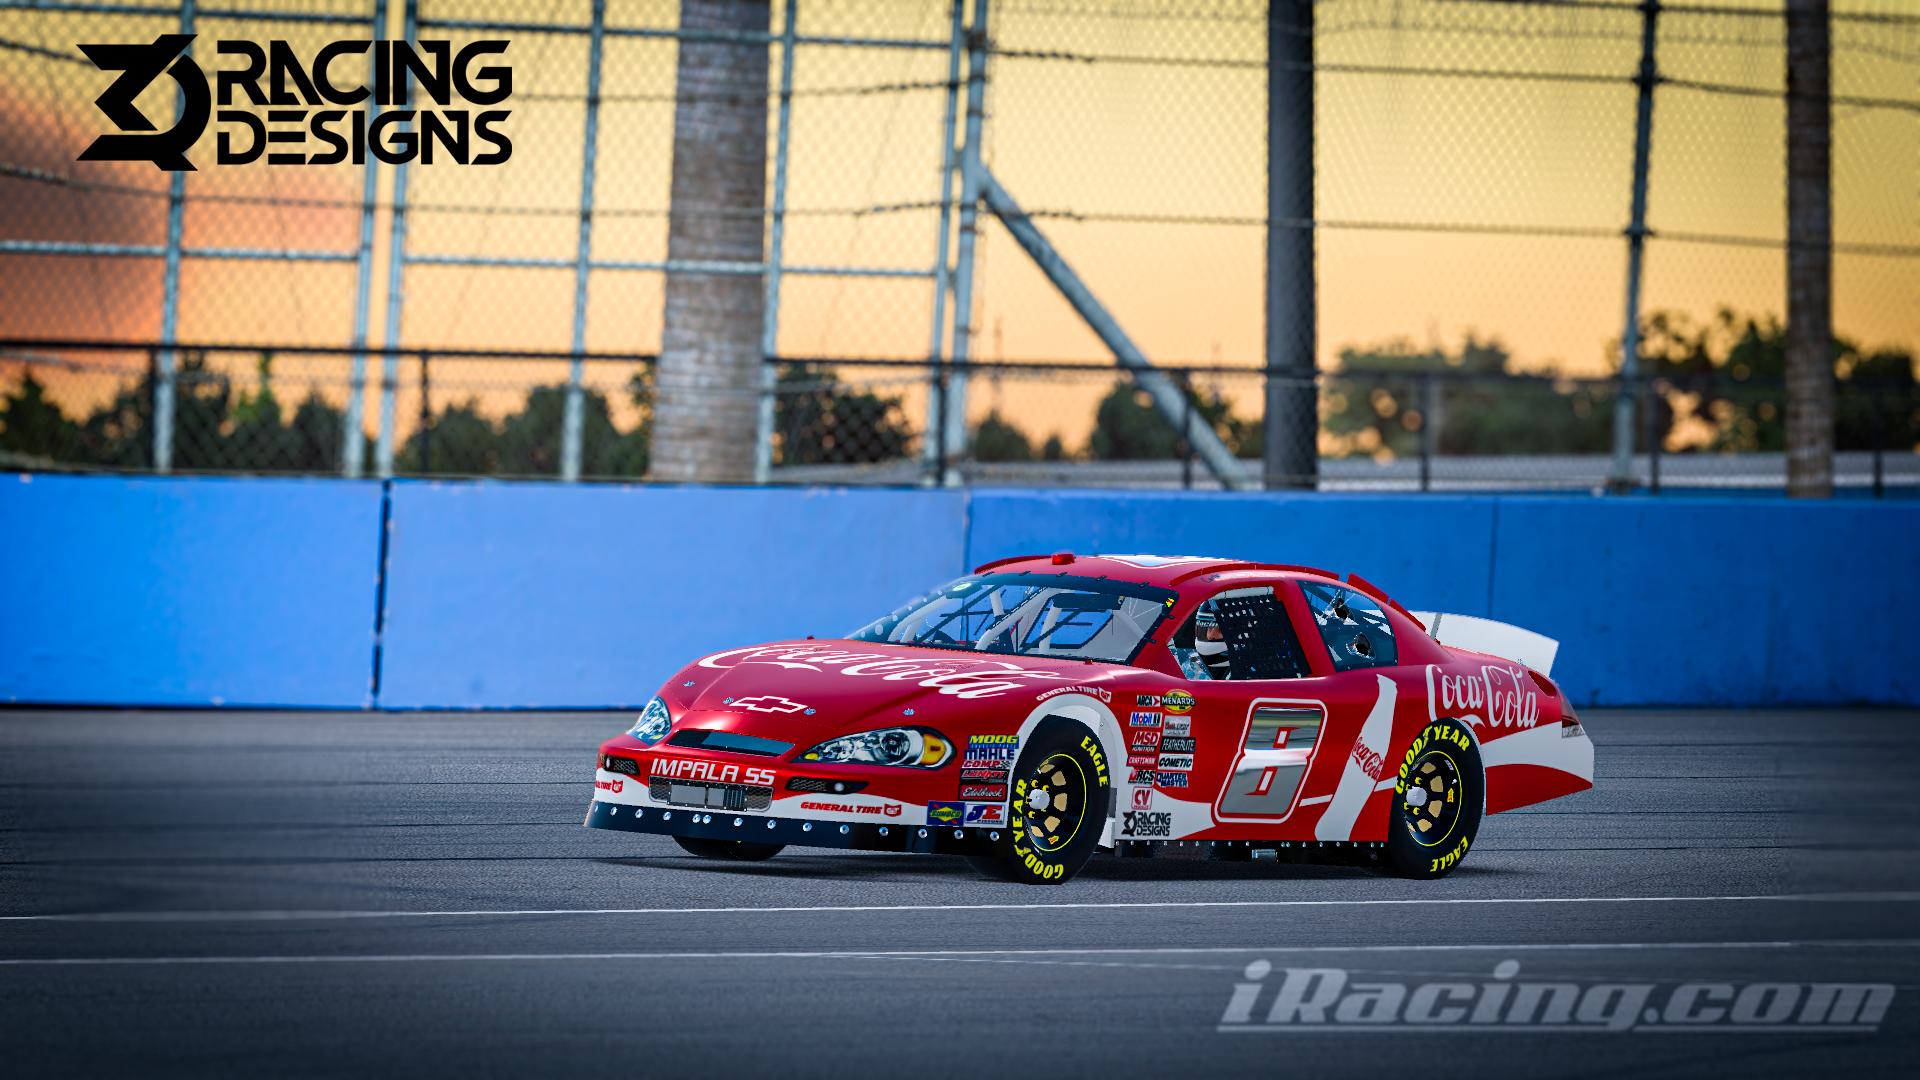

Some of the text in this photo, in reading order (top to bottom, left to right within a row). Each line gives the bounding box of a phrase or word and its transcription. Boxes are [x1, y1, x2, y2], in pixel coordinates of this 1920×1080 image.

[1036, 685, 1098, 701] GENERAL TIRE
[1161, 696, 1196, 706] MENARDS
[1131, 712, 1152, 725] Mobil
[969, 735, 1019, 744] MOOG
[1134, 732, 1159, 746] MSD
[1161, 738, 1195, 751] FEATHERLITE
[964, 749, 1015, 760] MAHLE
[1080, 735, 1109, 787] EAGLE
[1214, 697, 1328, 824] 8
[1395, 724, 1470, 794] GOODYEAR
[963, 760, 1001, 768] COMP
[1159, 757, 1193, 768] COMETIC
[650, 758, 777, 786] IMPALA SS
[1156, 772, 1187, 783] QUARTER
[1160, 779, 1188, 787] MASTER
[962, 787, 1003, 797] Edelbrock
[1134, 789, 1151, 806] CV
[801, 801, 855, 813] GENERAL
[856, 805, 882, 814] TIRE
[966, 805, 1003, 822] JE
[1137, 812, 1171, 825] RACING
[1012, 779, 1064, 879] GOODYEAR
[1136, 825, 1170, 837] DESIGNS
[1430, 836, 1469, 872] EAGLE
